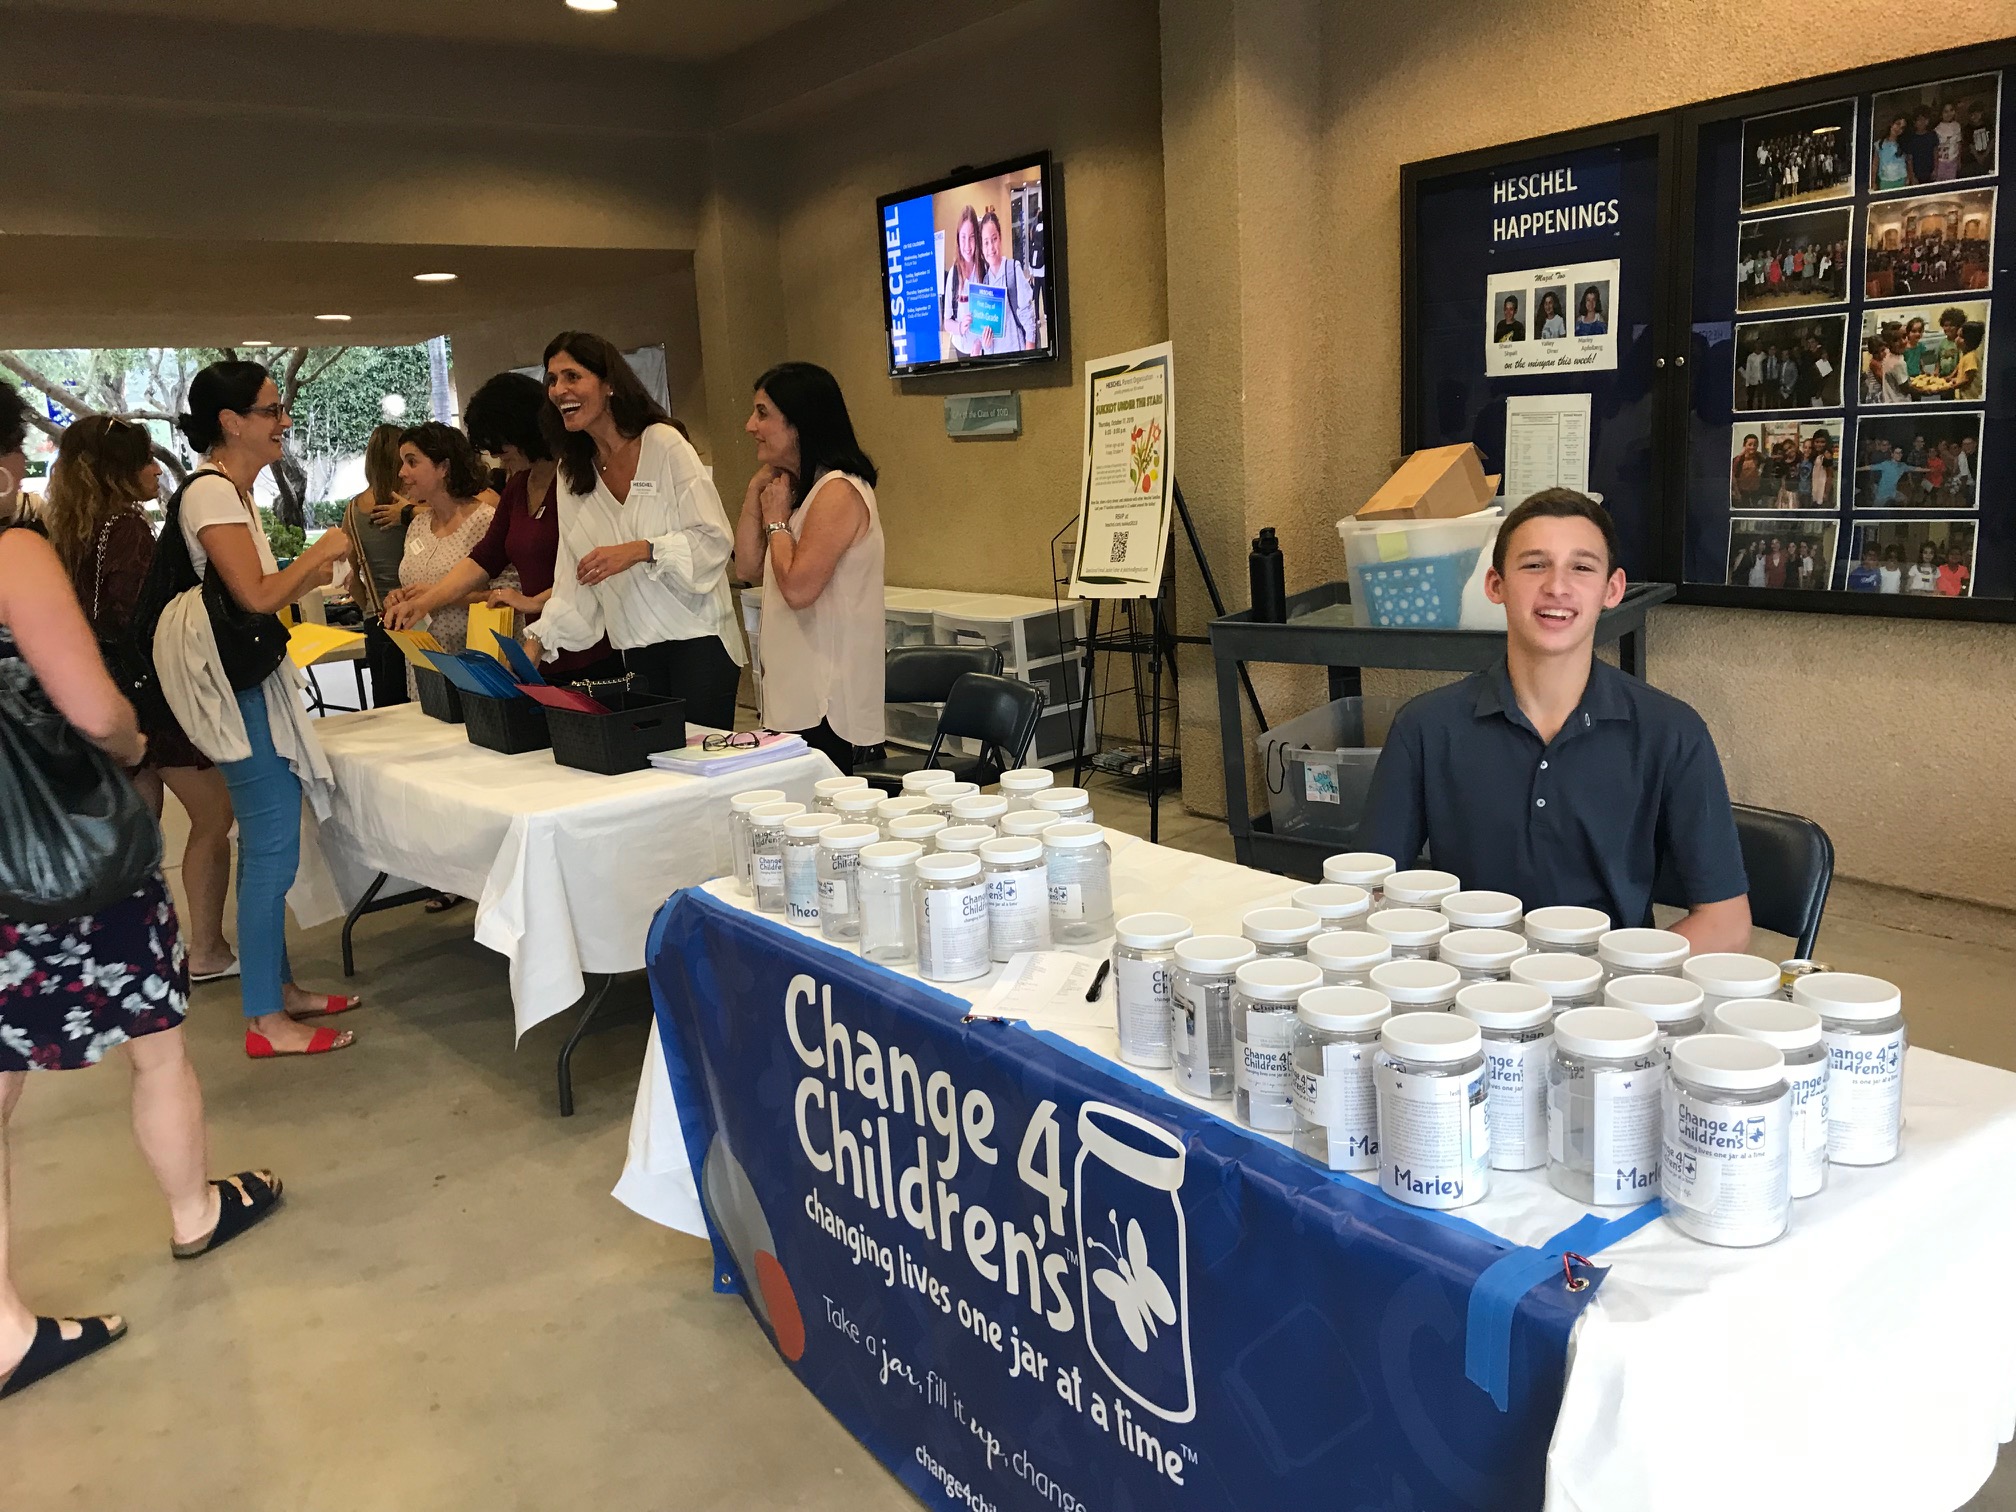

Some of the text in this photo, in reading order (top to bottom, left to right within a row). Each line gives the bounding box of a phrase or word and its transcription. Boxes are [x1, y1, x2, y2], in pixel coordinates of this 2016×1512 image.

[1494, 167, 1578, 204] HESCHEL
[1494, 199, 1619, 242] HAPPENINGS
[886, 206, 908, 364] HESCHEL
[1515, 358, 1525, 368] the
[1528, 359, 1555, 369] minyan
[1558, 354, 1571, 366] this
[1574, 353, 1597, 365] week!
[1106, 380, 1122, 388] HESCHEL
[1117, 399, 1135, 412] UNDER
[1136, 397, 1146, 409] THE
[1147, 394, 1163, 407] STARS
[790, 903, 818, 917] Theo
[1244, 1047, 1286, 1063] Change 4
[1245, 1057, 1286, 1071] Children's
[1877, 1047, 1886, 1059] 4
[785, 974, 1069, 1237] Change 4
[1679, 1104, 1744, 1136] Change 4
[1679, 1118, 1744, 1149] Children's
[1676, 1152, 1682, 1163] 4
[1698, 1147, 1712, 1157] lives
[1728, 1152, 1738, 1160] jar
[1394, 1164, 1463, 1199] Marley
[795, 1077, 1075, 1332] Children's
[805, 1188, 894, 1287] changing
[899, 1245, 951, 1314] lives
[957, 1298, 1003, 1352] one
[1009, 1326, 1048, 1378] jar
[1057, 1364, 1082, 1413] at
[1091, 1391, 1110, 1432] a
[1114, 1402, 1184, 1486] time
[822, 1295, 860, 1344] Take
[865, 1333, 876, 1356] a
[879, 1339, 923, 1394] jar,
[926, 1371, 948, 1409] fill
[953, 1392, 966, 1425] it
[970, 1418, 1009, 1470] up,
